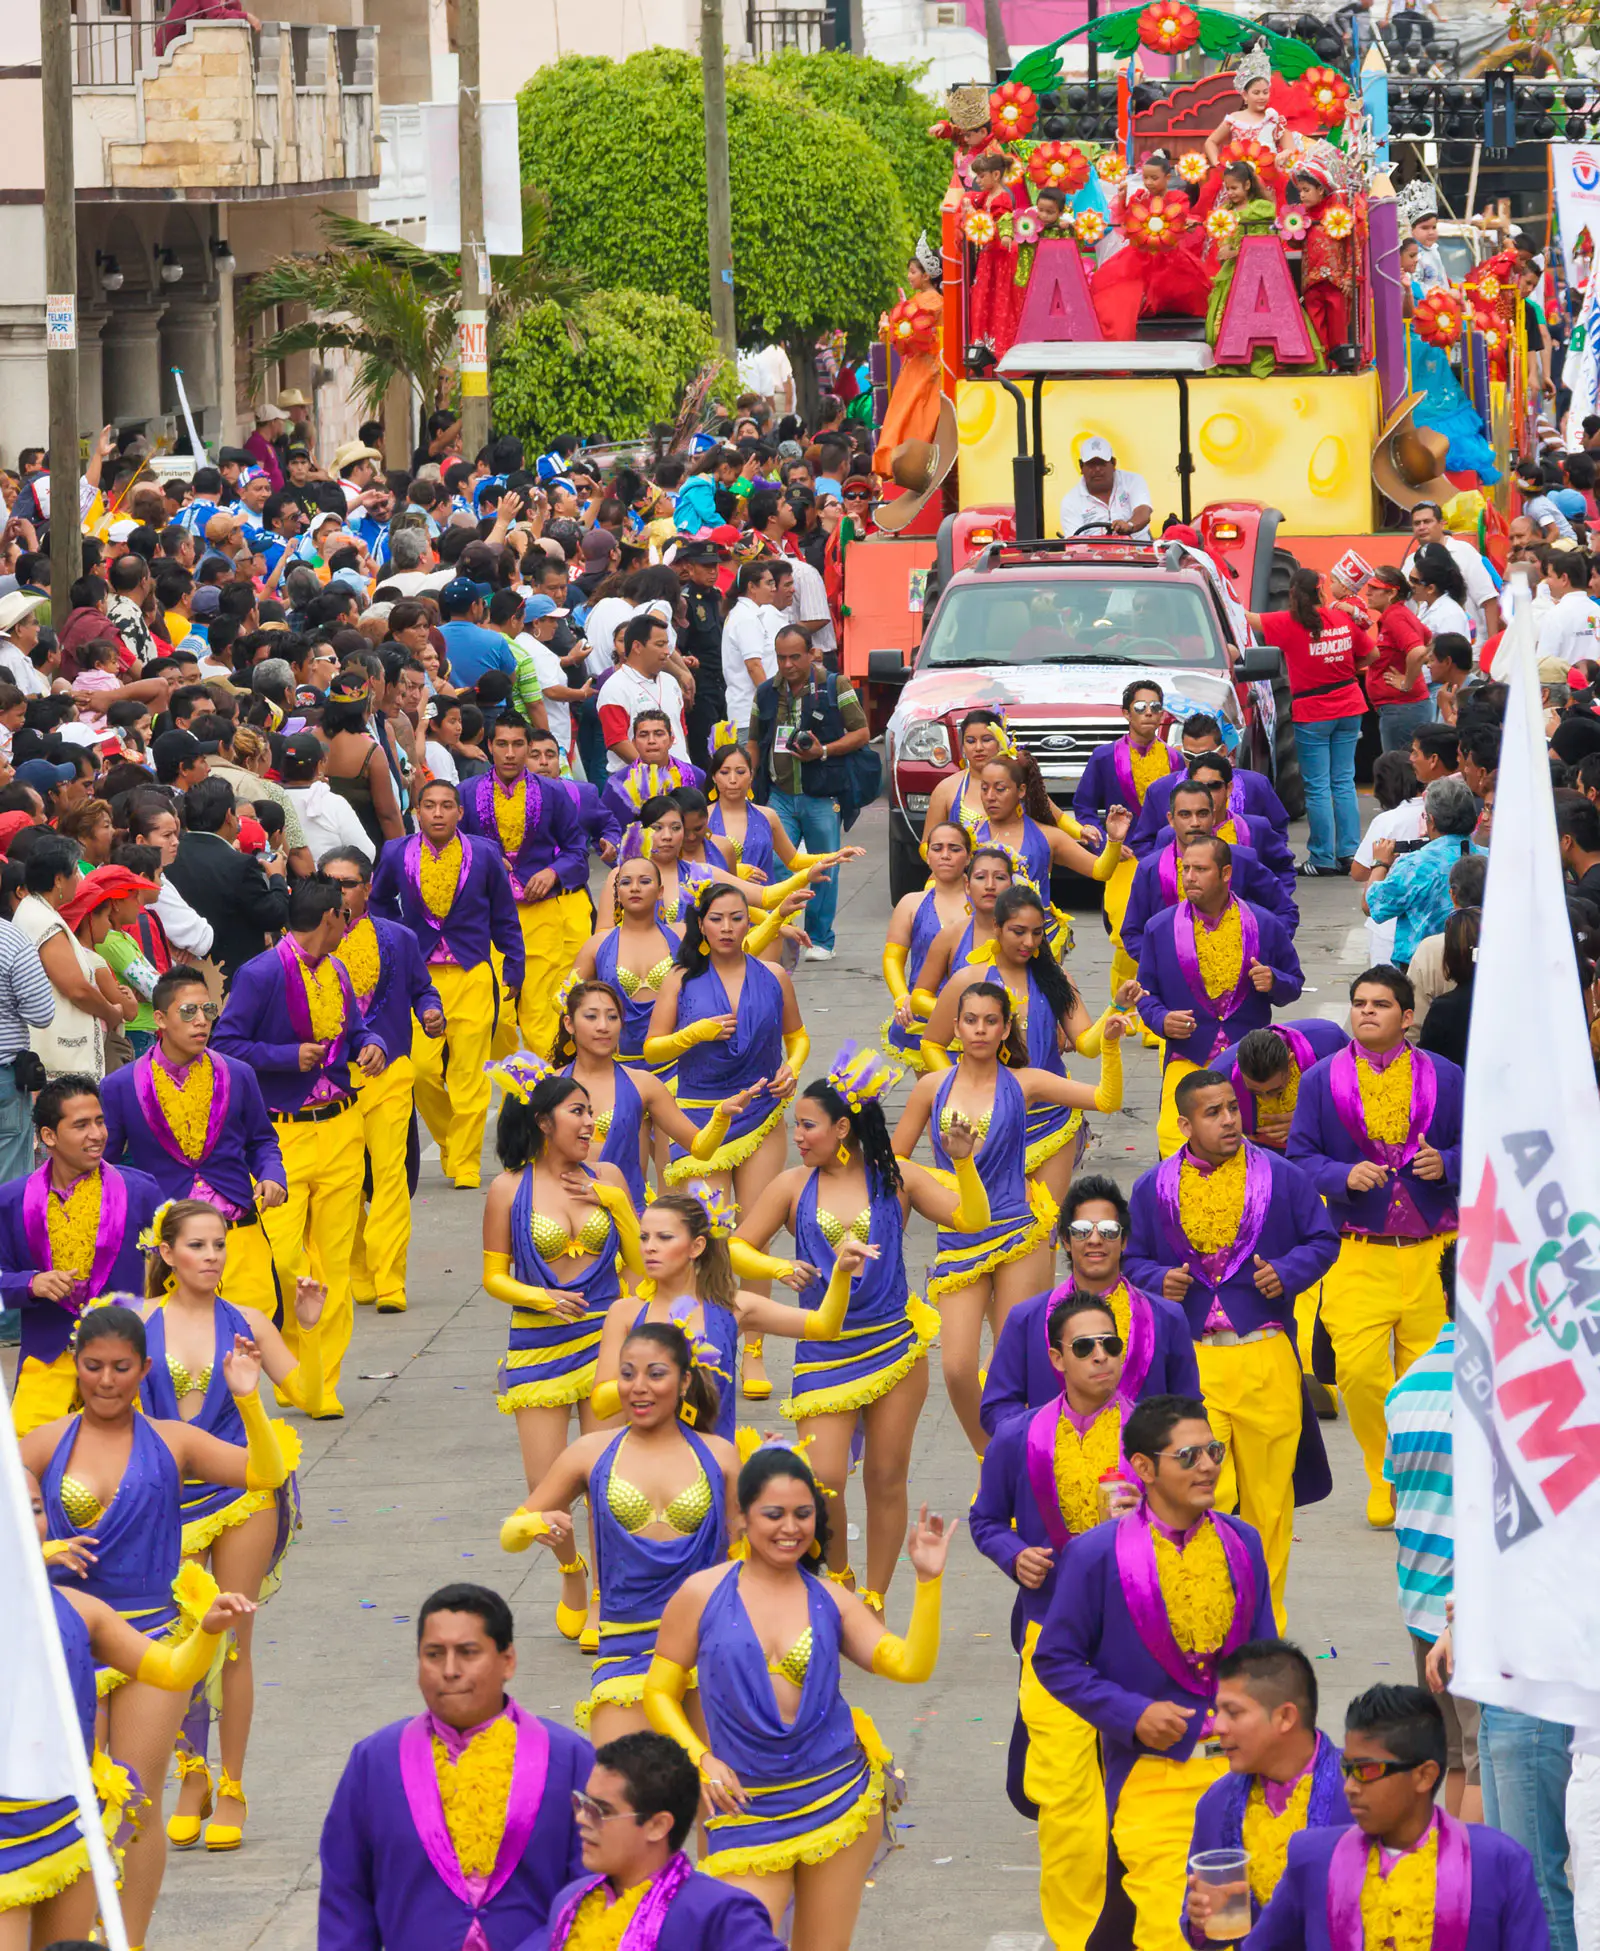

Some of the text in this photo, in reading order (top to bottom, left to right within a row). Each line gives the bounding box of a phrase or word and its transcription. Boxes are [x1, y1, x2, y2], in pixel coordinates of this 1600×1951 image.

[1214, 235, 1317, 364] A
[48, 313, 73, 322] TELMEX
[1323, 655, 1344, 664] 2010
[1048, 737, 1071, 747] Ford
